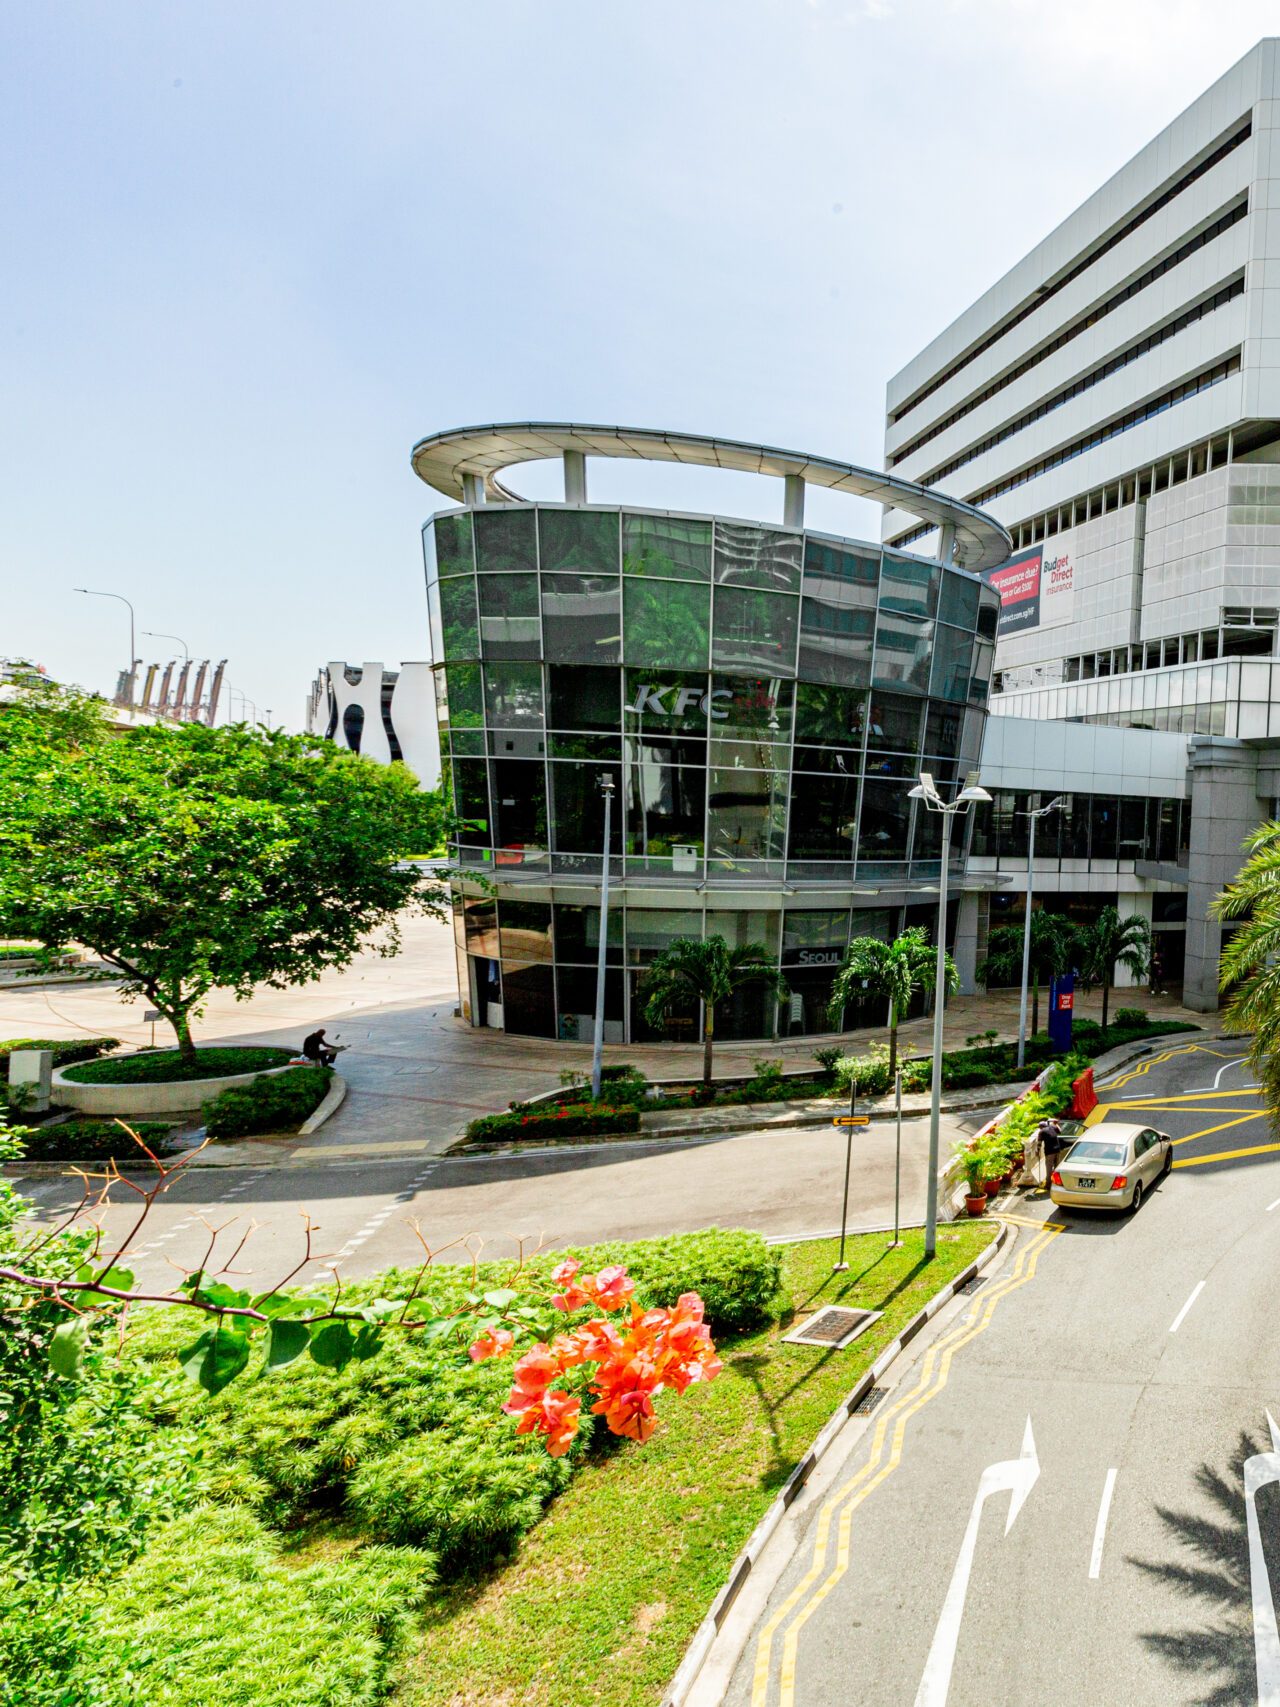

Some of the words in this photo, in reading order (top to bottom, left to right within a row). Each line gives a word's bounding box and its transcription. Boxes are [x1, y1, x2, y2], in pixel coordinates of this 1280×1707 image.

[1043, 554, 1068, 573] Budget
[1050, 566, 1073, 583] Direct
[1046, 582, 1072, 595] insurance
[633, 684, 733, 719] KFC
